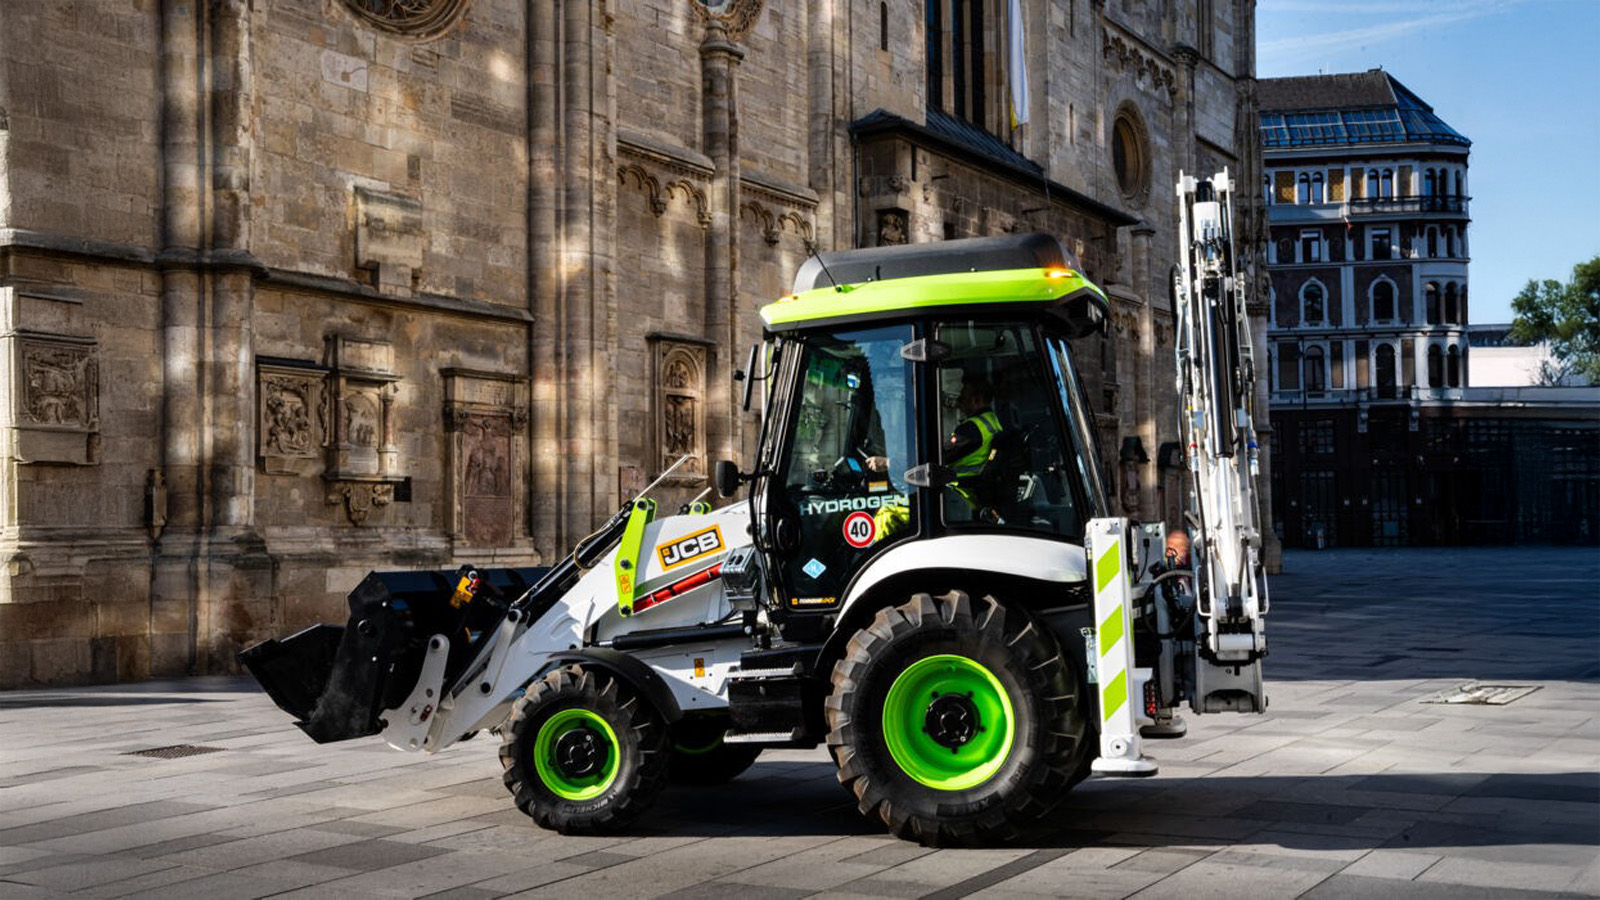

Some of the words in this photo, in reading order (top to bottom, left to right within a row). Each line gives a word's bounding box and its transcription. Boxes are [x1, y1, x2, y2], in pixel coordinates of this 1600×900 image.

[800, 494, 910, 516] HYDROGEN
[850, 521, 869, 538] 40
[664, 531, 720, 564] JCB
